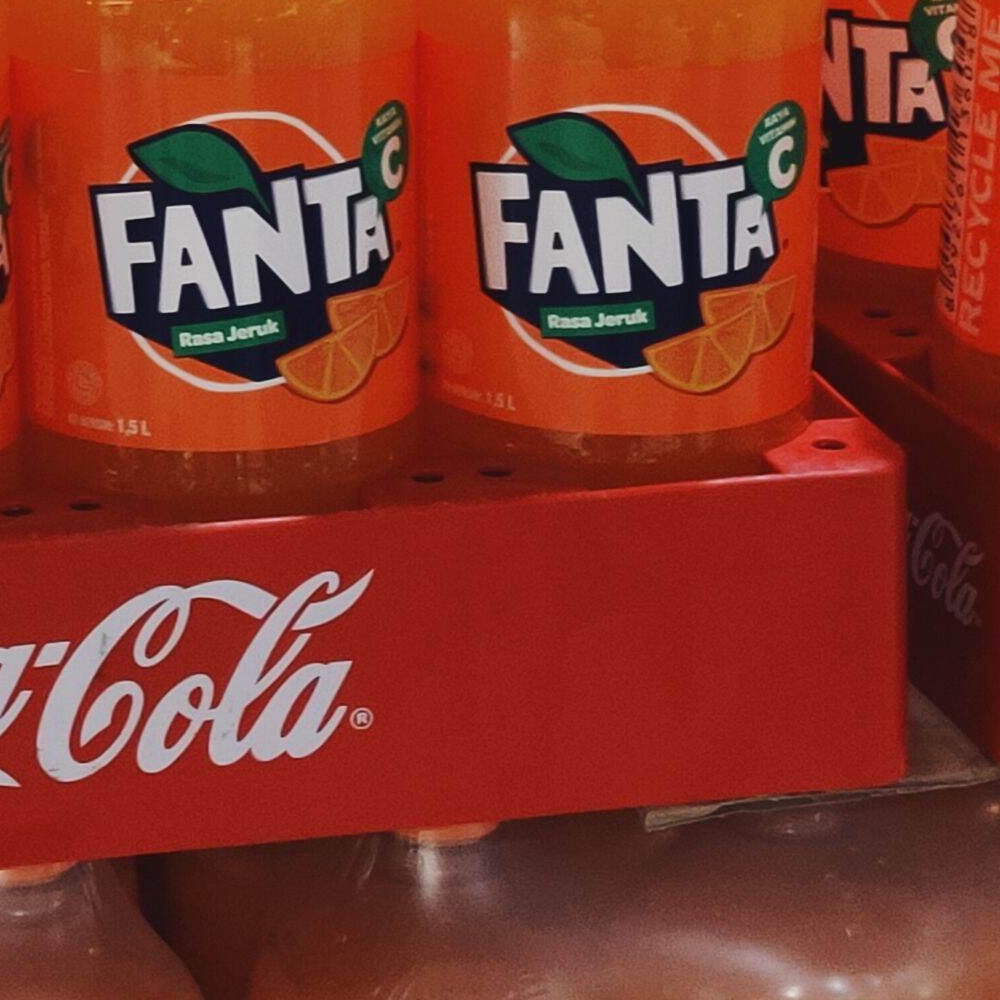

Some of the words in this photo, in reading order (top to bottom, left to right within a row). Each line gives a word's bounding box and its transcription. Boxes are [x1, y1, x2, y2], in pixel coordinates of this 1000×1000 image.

[380, 135, 404, 190] C
[768, 135, 798, 190] C
[96, 167, 391, 315] FANTA
[476, 165, 775, 295] FANTA
[958, 104, 998, 336] RECYCLE
[178, 330, 224, 348] Rasa
[226, 318, 280, 343] Jeruk
[547, 313, 592, 329] Rasa
[595, 308, 648, 328] Jeruk
